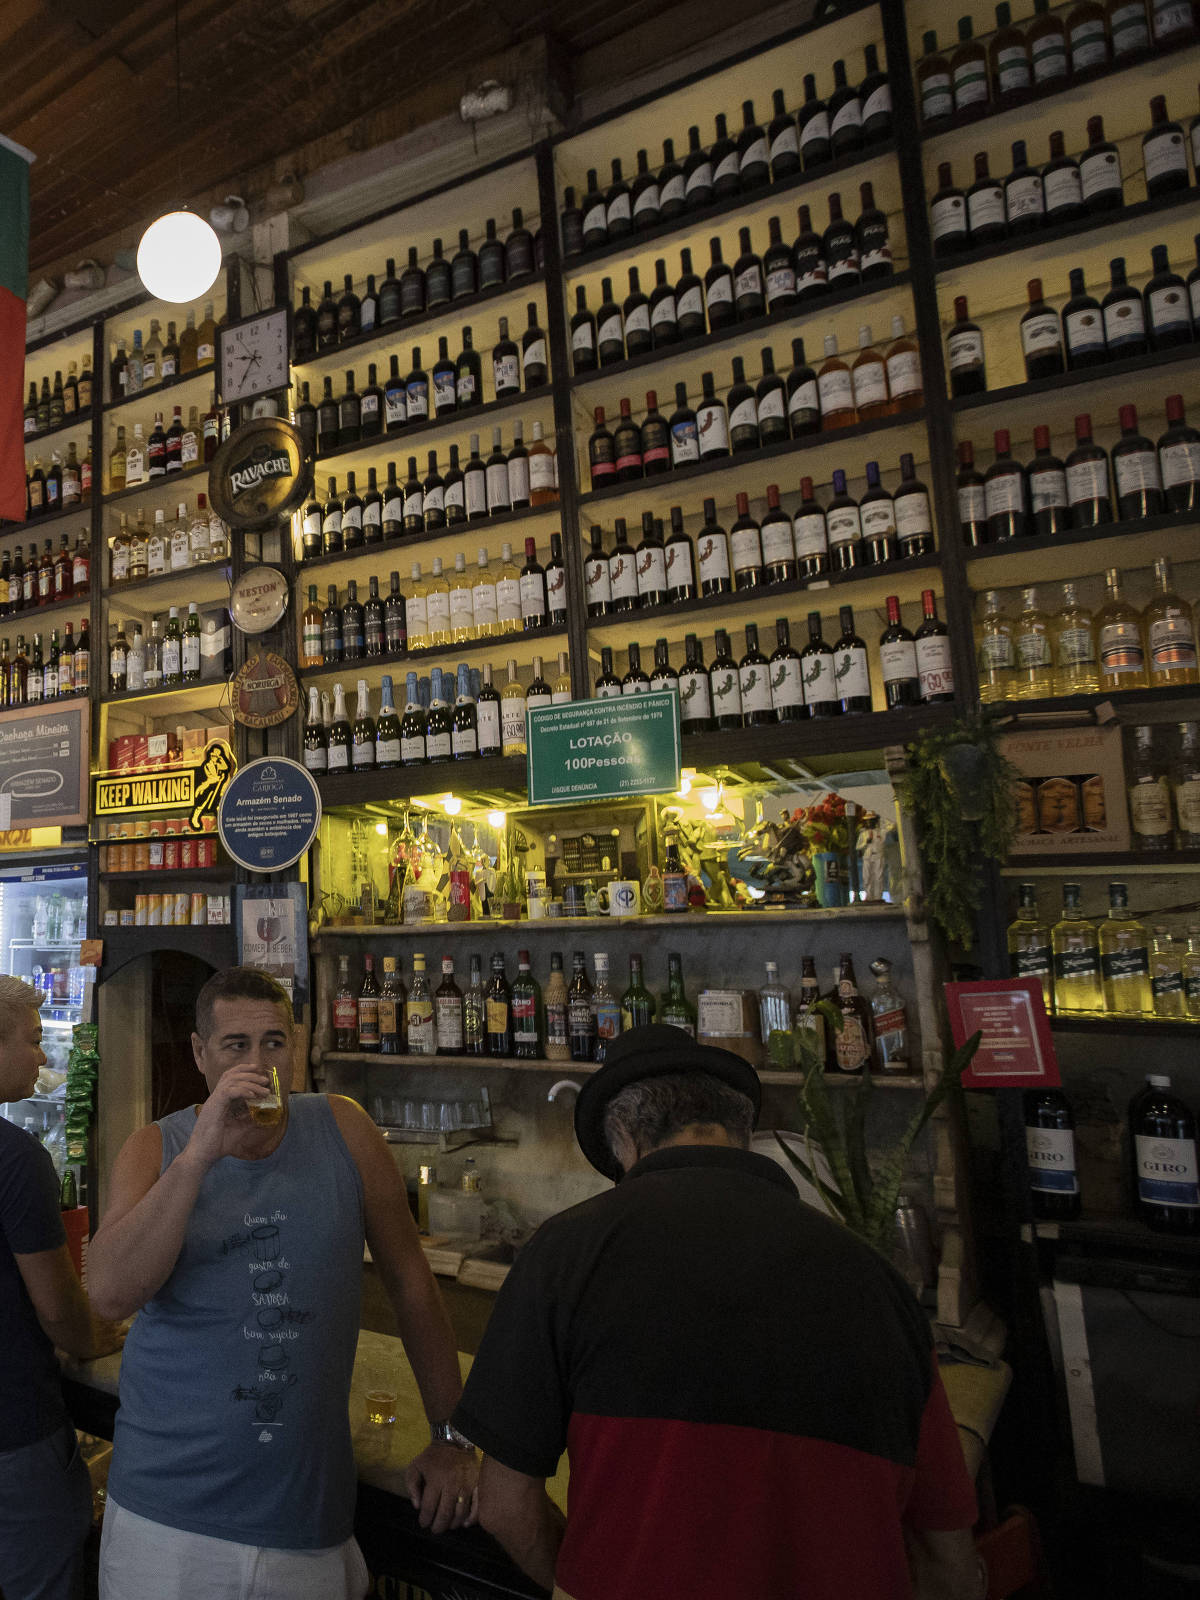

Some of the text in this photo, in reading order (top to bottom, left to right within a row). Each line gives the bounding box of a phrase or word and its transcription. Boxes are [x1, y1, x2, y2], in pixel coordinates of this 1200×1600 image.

[250, 325, 259, 336] 12
[231, 457, 290, 494] RAVACHE
[534, 712, 553, 722] CÓDIGO
[554, 711, 561, 720] DE
[562, 708, 594, 720] SEGURANÇA
[594, 705, 617, 715] CONTRA
[617, 701, 643, 712] INCÊNDIO
[648, 698, 670, 708] PÂNICO
[540, 725, 559, 733] Decreto
[559, 722, 580, 731] Estadual
[643, 713, 650, 721] de
[36, 723, 68, 737] Mineira
[569, 732, 632, 750] LOTAÇÃO
[100, 784, 130, 808] KEEP
[131, 777, 189, 805] WALKING
[552, 785, 570, 793] DISQUE
[571, 783, 598, 792] DENÚNCIA
[236, 793, 302, 806] Armazém Senado
[243, 942, 293, 953] COMER BEBER
[411, 1016, 420, 1025] 51
[1144, 1161, 1187, 1173] GIRO
[244, 1213, 268, 1226] Quem
